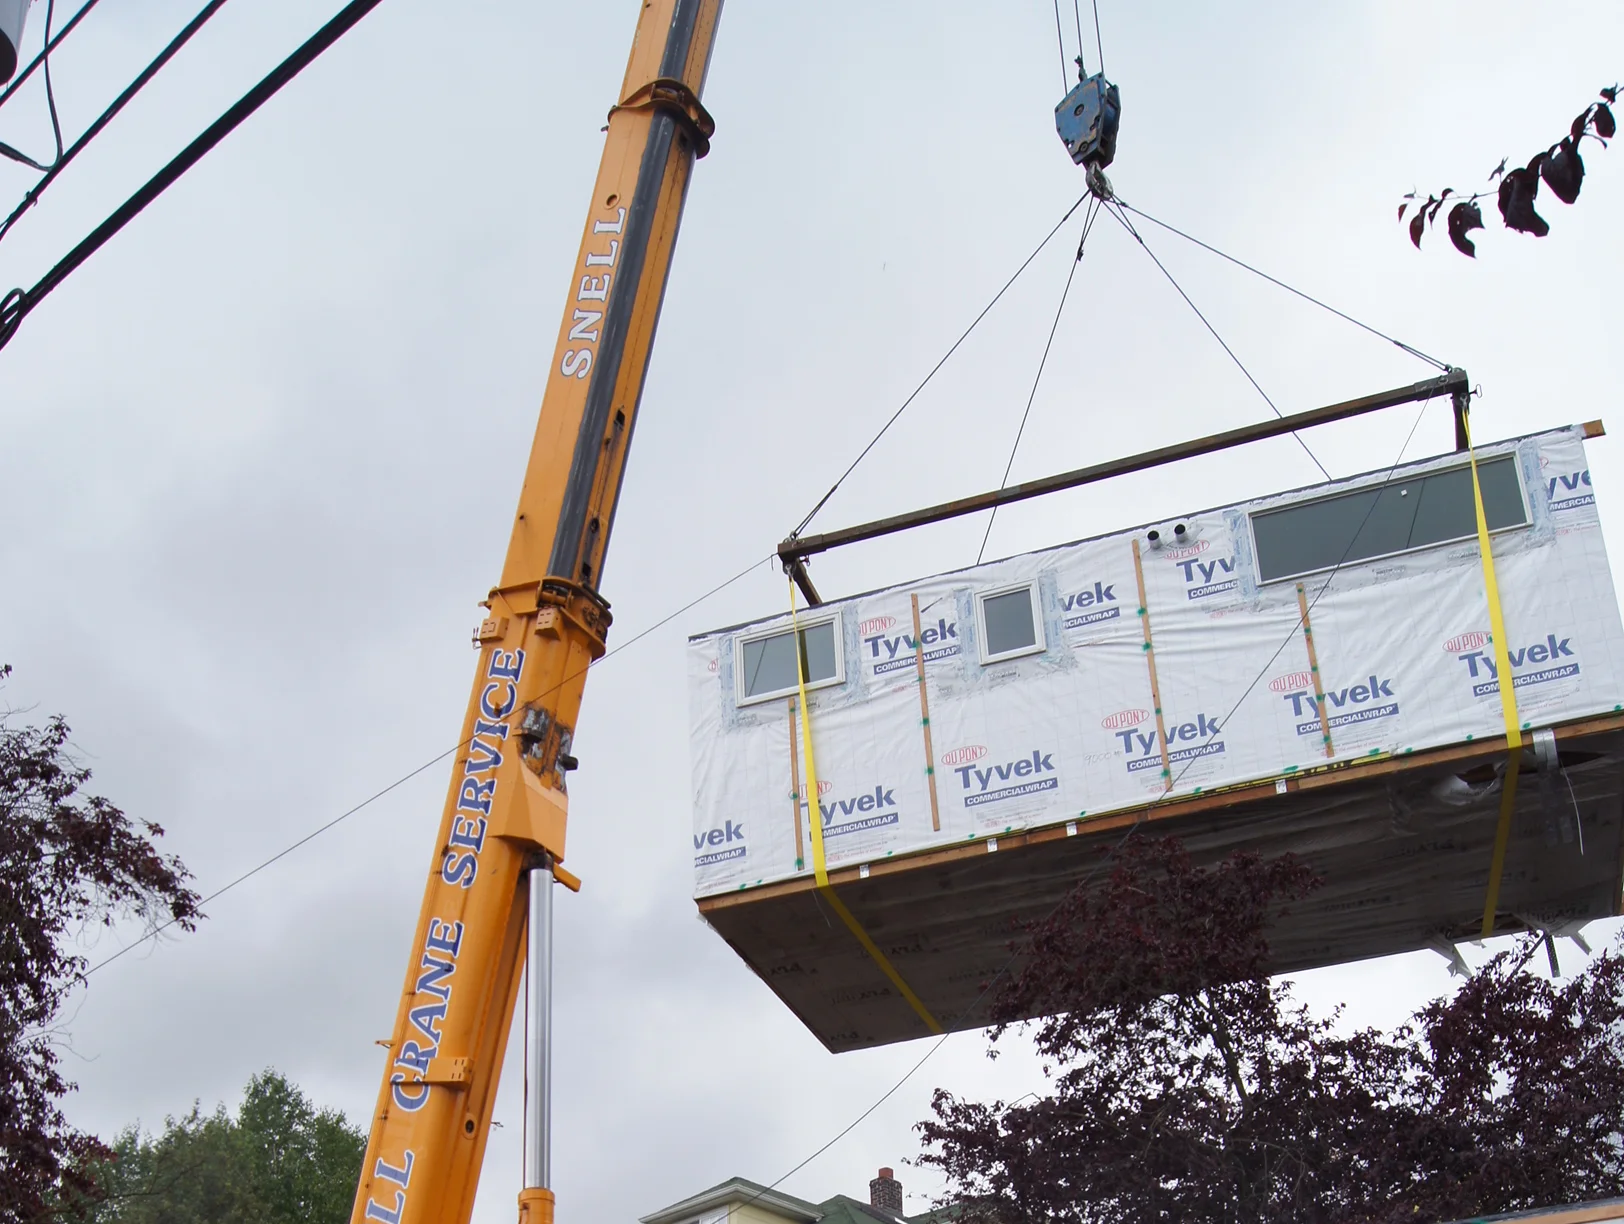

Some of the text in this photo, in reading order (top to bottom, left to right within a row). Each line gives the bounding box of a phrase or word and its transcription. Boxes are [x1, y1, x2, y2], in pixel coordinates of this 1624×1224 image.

[560, 206, 627, 380] SNELL
[1176, 555, 1236, 584] Tyv
[1057, 581, 1117, 612] vek
[864, 618, 959, 659] Tyvek
[875, 647, 958, 673] COMMERCALWRAP
[1458, 634, 1575, 680] Tyvek
[1283, 675, 1395, 719] Tyvek
[1476, 666, 1574, 695] COMRCIALWRAP
[1115, 713, 1222, 756] Tyvek
[954, 750, 1056, 792] Tyvek
[966, 779, 1055, 806] COMMERCIALWRAP
[693, 820, 745, 849] vek
[823, 815, 894, 839] MMERCIALWRAP
[391, 917, 465, 1113] CRANE
[441, 648, 526, 889] SERVICE
